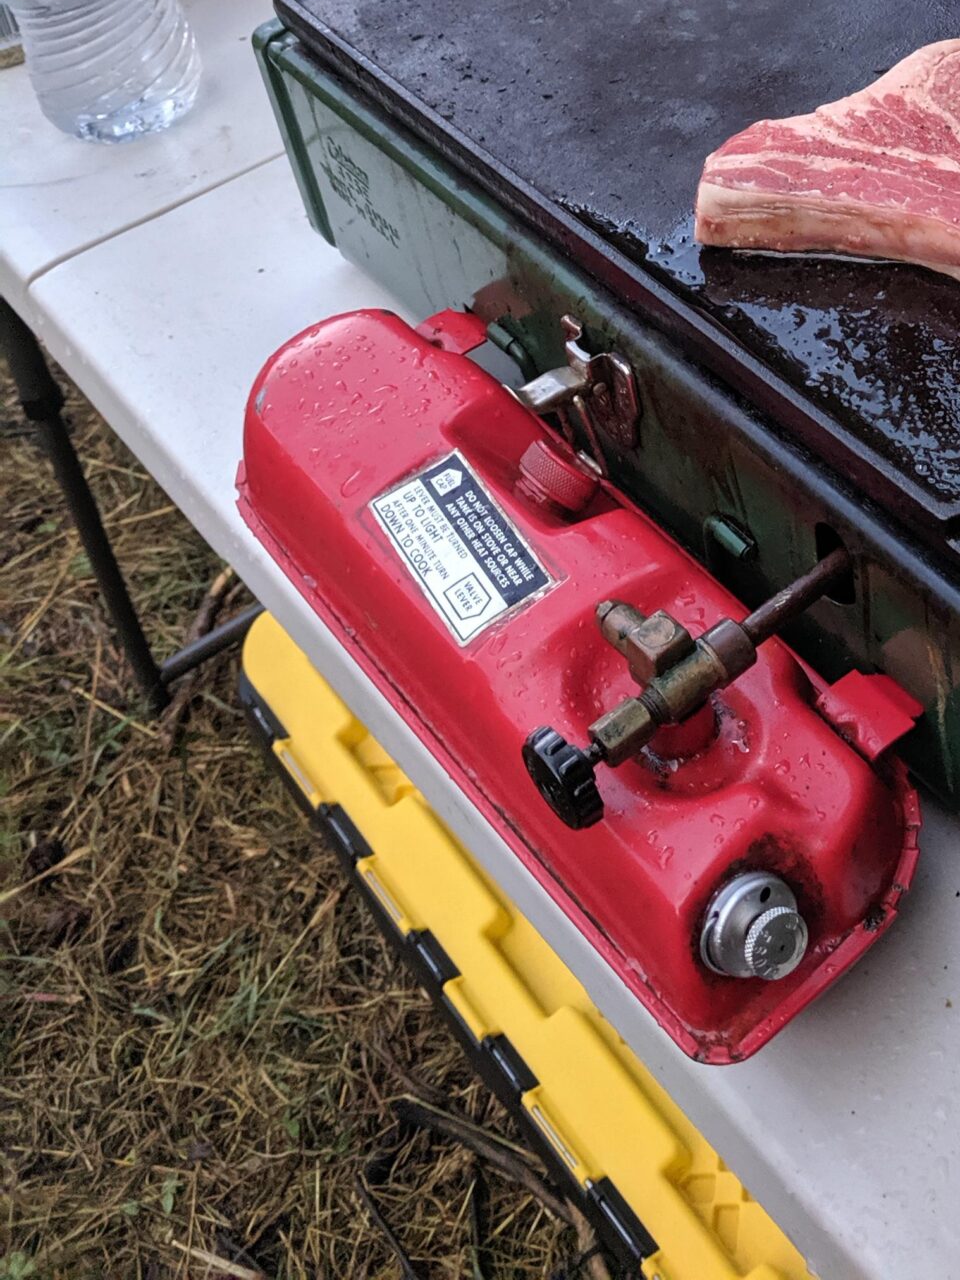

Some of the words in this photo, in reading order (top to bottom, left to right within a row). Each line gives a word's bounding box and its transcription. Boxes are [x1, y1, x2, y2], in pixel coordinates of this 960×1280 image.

[435, 478, 446, 490] CAP
[442, 471, 456, 487] FUEL
[402, 490, 416, 505] UP
[411, 504, 425, 518] TO
[419, 516, 443, 544] LIGHT
[454, 495, 472, 516] TANK
[467, 512, 477, 522] IS
[379, 503, 406, 534] DOWN
[413, 485, 430, 505] LEVER
[426, 504, 443, 524] MUST
[439, 523, 449, 532] BE
[445, 532, 468, 559] TURNED
[471, 519, 485, 534] ON
[391, 498, 409, 519] AFTER
[404, 517, 419, 534] ONE
[413, 533, 437, 560] MINUTE
[432, 560, 449, 579] TURN
[400, 534, 415, 548] TO
[444, 501, 460, 519] ANY
[455, 516, 475, 540] OTHER
[470, 538, 488, 557] HEAT
[483, 555, 510, 588] SOURCES
[464, 489, 477, 503] DO
[472, 500, 487, 517] NOT
[483, 515, 507, 544] LOOSEN
[502, 542, 518, 559] CAP
[513, 556, 534, 581] WHILE
[480, 532, 501, 555] STOVE
[407, 547, 433, 577] COOK
[495, 552, 509, 567] OR
[504, 564, 523, 586] NEAR
[453, 588, 473, 611] LEVER
[462, 580, 483, 605] VALVE
